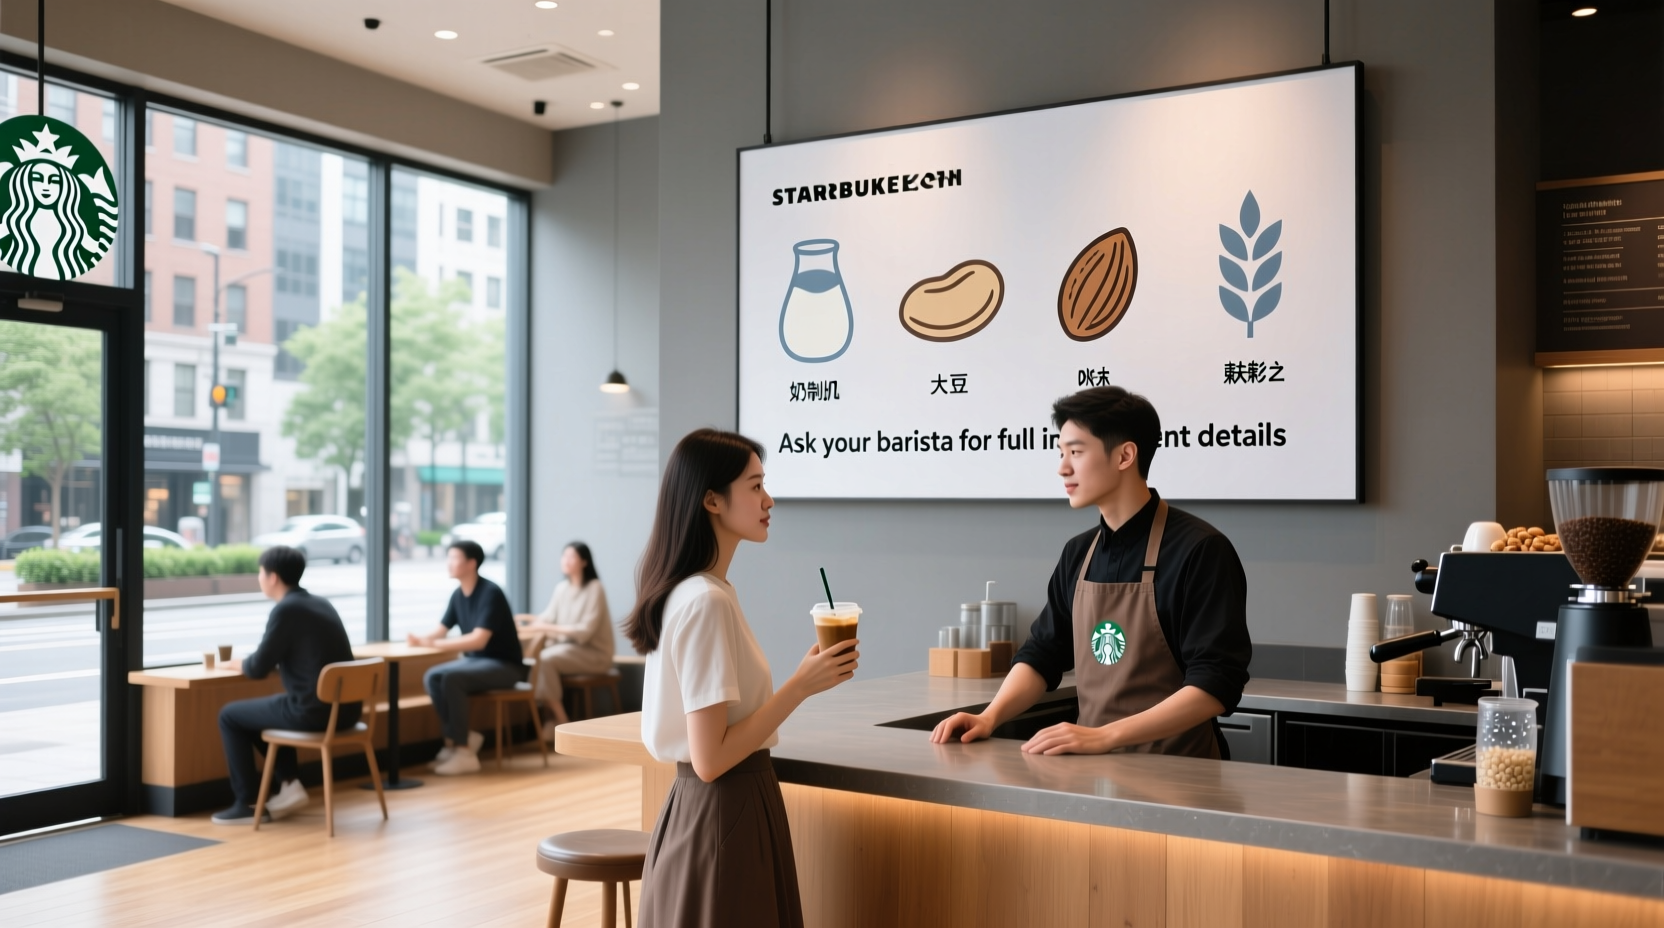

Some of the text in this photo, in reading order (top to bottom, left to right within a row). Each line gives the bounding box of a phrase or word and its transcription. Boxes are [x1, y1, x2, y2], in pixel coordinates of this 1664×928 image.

[930, 373, 969, 395] 大豆
[778, 431, 817, 454] Ask
[822, 436, 872, 459] your
[877, 429, 953, 453] barista
[958, 428, 993, 452] for
[997, 426, 1035, 451] full
[1197, 421, 1287, 448] details
